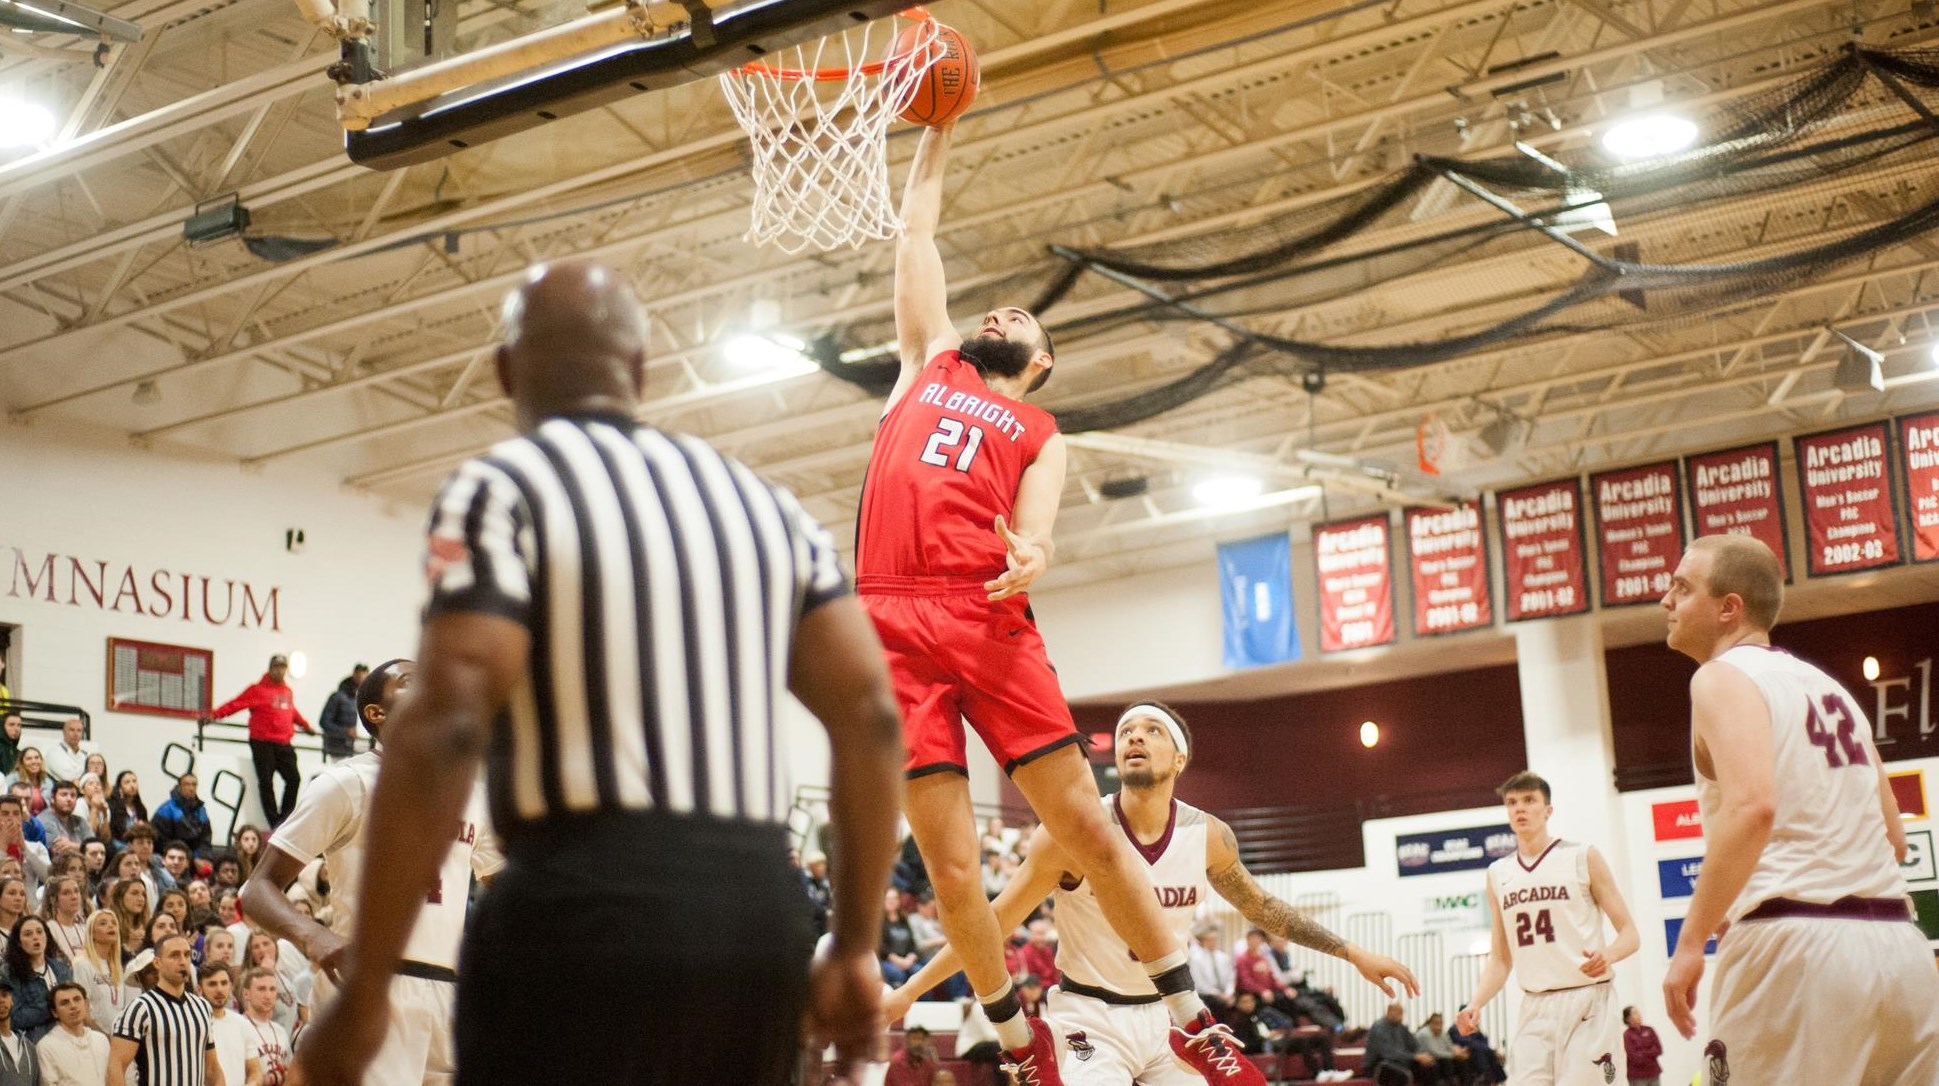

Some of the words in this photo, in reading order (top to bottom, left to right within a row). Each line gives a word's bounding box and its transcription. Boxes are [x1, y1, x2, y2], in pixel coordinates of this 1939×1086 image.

[942, 67, 960, 98] THE
[919, 383, 1026, 442] ALBRIGHT
[919, 416, 984, 473] 21
[1807, 436, 1882, 468] Arcadia
[1601, 472, 1671, 502] Arcadia
[1697, 456, 1770, 488] Arcadia
[1807, 460, 1882, 487] University
[1505, 489, 1572, 520] Arcadia
[1698, 480, 1771, 507] University
[1815, 493, 1845, 509] Men's
[1846, 488, 1880, 504] Soccer
[1602, 497, 1672, 522] University
[1506, 512, 1573, 539] University
[1823, 539, 1884, 566] 2002-03
[1, 546, 282, 633] MNASIUM
[1520, 586, 1575, 612] 2001-02
[1616, 572, 1672, 598] 2001-02
[1806, 693, 1869, 768] 42
[1503, 885, 1569, 910] ARCADIA
[1516, 909, 1555, 947] 24
